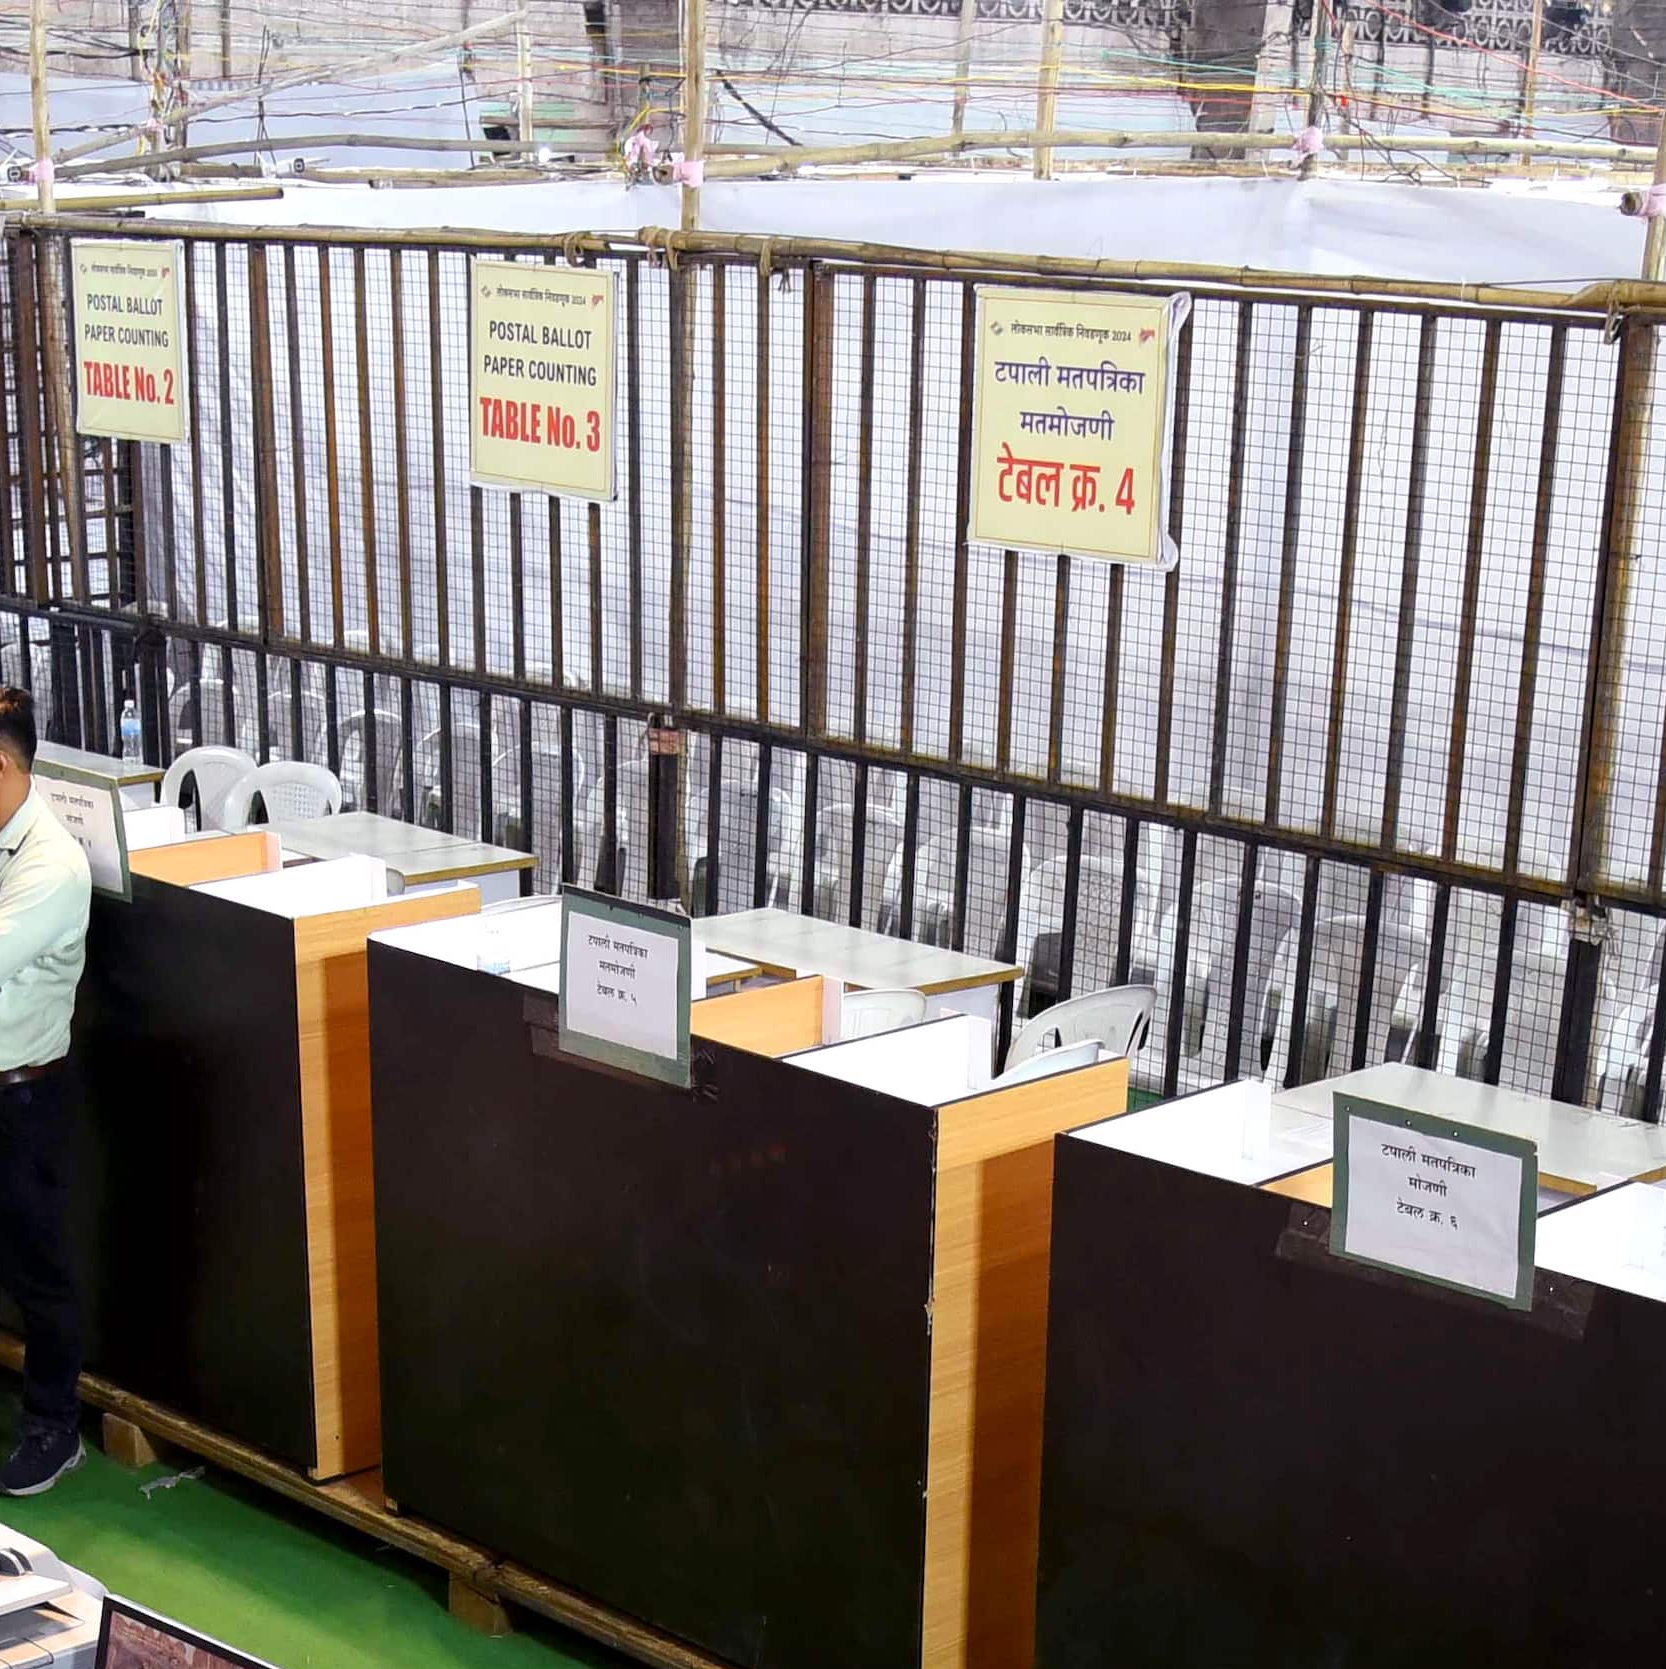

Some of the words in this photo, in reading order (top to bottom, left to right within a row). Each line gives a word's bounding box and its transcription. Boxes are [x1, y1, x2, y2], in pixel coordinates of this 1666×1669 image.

[87, 293, 123, 313] POSTAL
[127, 297, 163, 316] BALLOT
[85, 324, 115, 342] PAPER
[118, 327, 169, 348] COUNTING
[489, 320, 537, 344] POSTAL
[542, 326, 592, 350] BALLOT
[1112, 330, 1131, 342] 2024
[84, 361, 131, 400] TABLE
[134, 366, 161, 404] No.
[163, 369, 174, 405] 2
[484, 355, 524, 378] PAPER
[529, 361, 597, 386] COUNTING
[995, 356, 1051, 387] टपाली
[1057, 360, 1145, 394] मतपत्रिका
[480, 396, 541, 443] TABLE
[547, 405, 581, 449] No.
[586, 411, 600, 452] 3
[1020, 406, 1114, 441] मतमोजणी
[997, 441, 1064, 508] टेबल
[1070, 463, 1105, 512] क्र.
[1115, 467, 1135, 515] 4
[1381, 1143, 1416, 1163] टपाली
[1421, 1153, 1476, 1179] मतपत्रिका
[1408, 1173, 1448, 1197] मोजणी
[1397, 1197, 1425, 1219] टेबल
